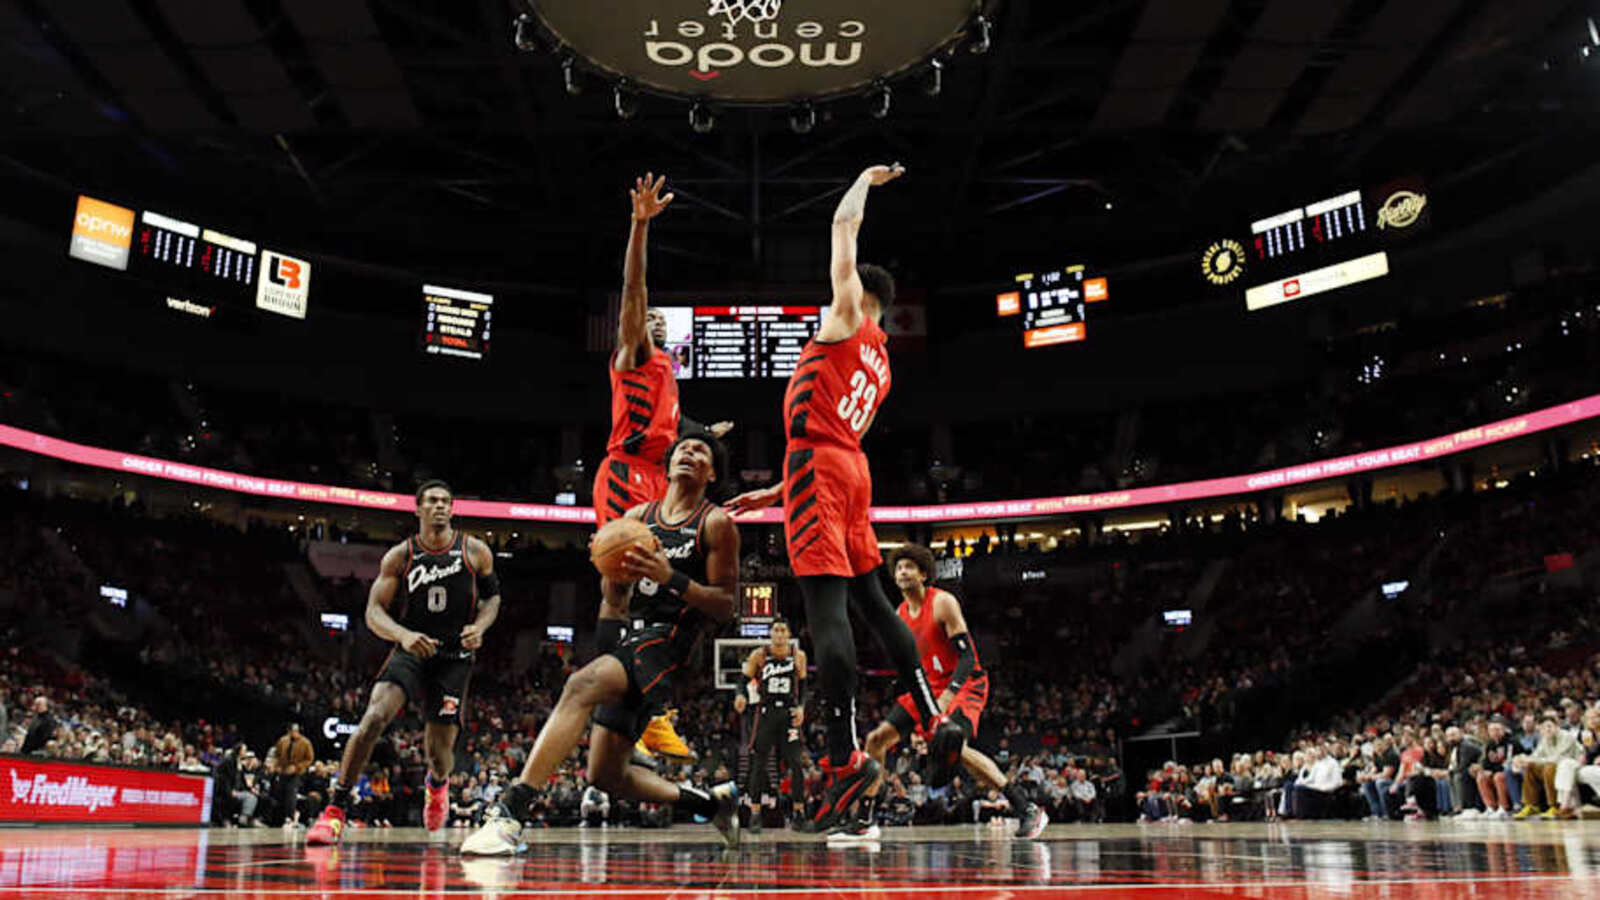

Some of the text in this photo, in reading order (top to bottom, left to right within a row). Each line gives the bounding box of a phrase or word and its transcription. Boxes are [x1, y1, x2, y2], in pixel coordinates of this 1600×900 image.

[644, 20, 866, 40] center
[645, 41, 862, 73] moda
[837, 369, 878, 432] 33
[1357, 453, 1389, 467] YOUR
[236, 478, 265, 491] YOUR
[407, 557, 463, 593] Detroit
[427, 585, 447, 613] 0
